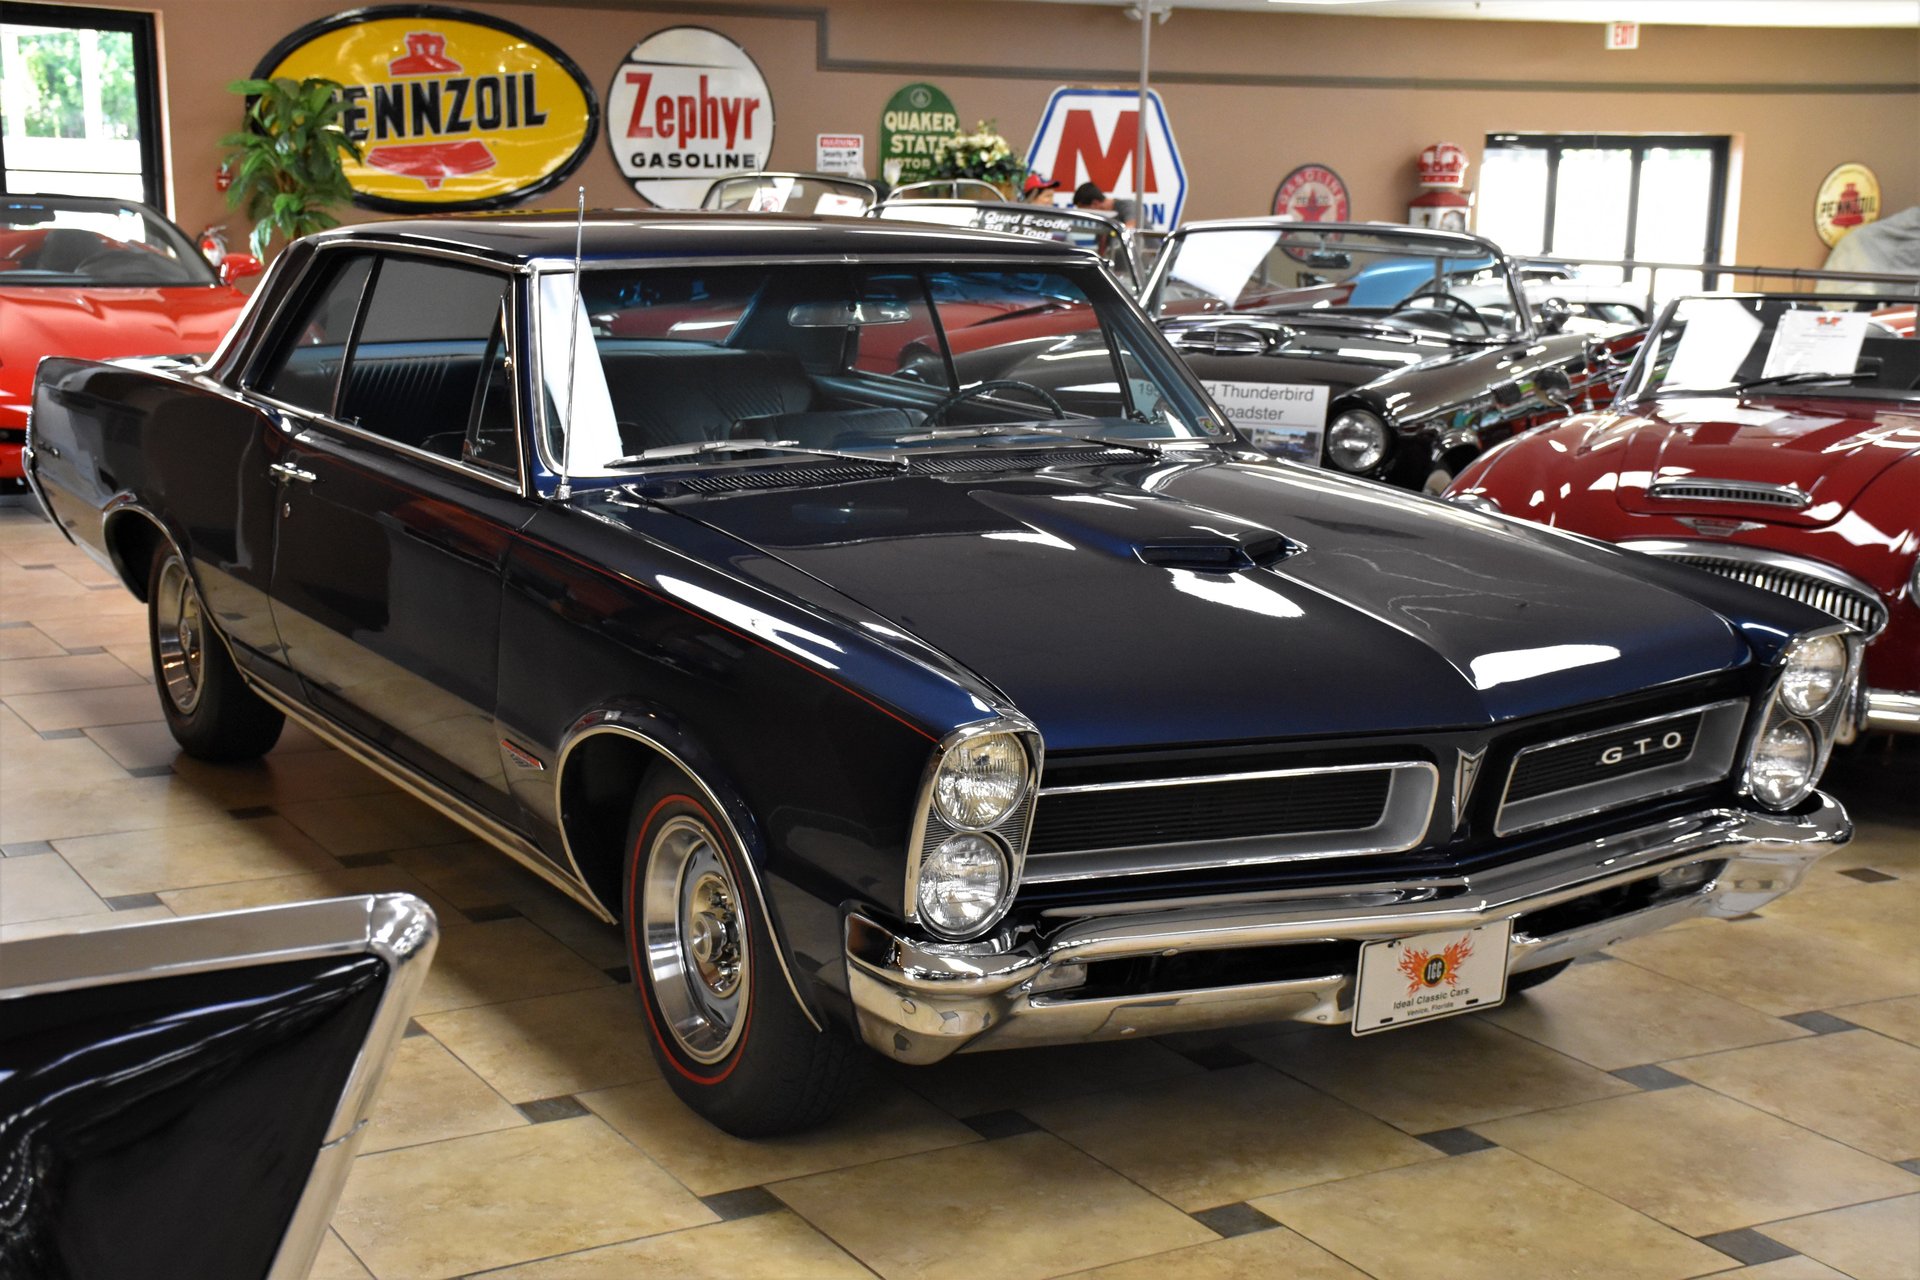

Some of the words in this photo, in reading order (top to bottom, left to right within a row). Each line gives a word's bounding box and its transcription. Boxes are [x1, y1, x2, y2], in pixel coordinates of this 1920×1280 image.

[333, 73, 548, 141] ENNZOIL
[625, 72, 760, 150] Zephyr
[884, 111, 956, 132] QUAKER
[631, 152, 756, 168] GASOLINE
[985, 211, 1021, 224] Quad
[1221, 385, 1314, 401] Thunderbird
[1601, 731, 1682, 765] GTO
[1393, 998, 1414, 1009] Ideal
[1416, 992, 1448, 1004] Classic
[1450, 987, 1470, 998] Cars
